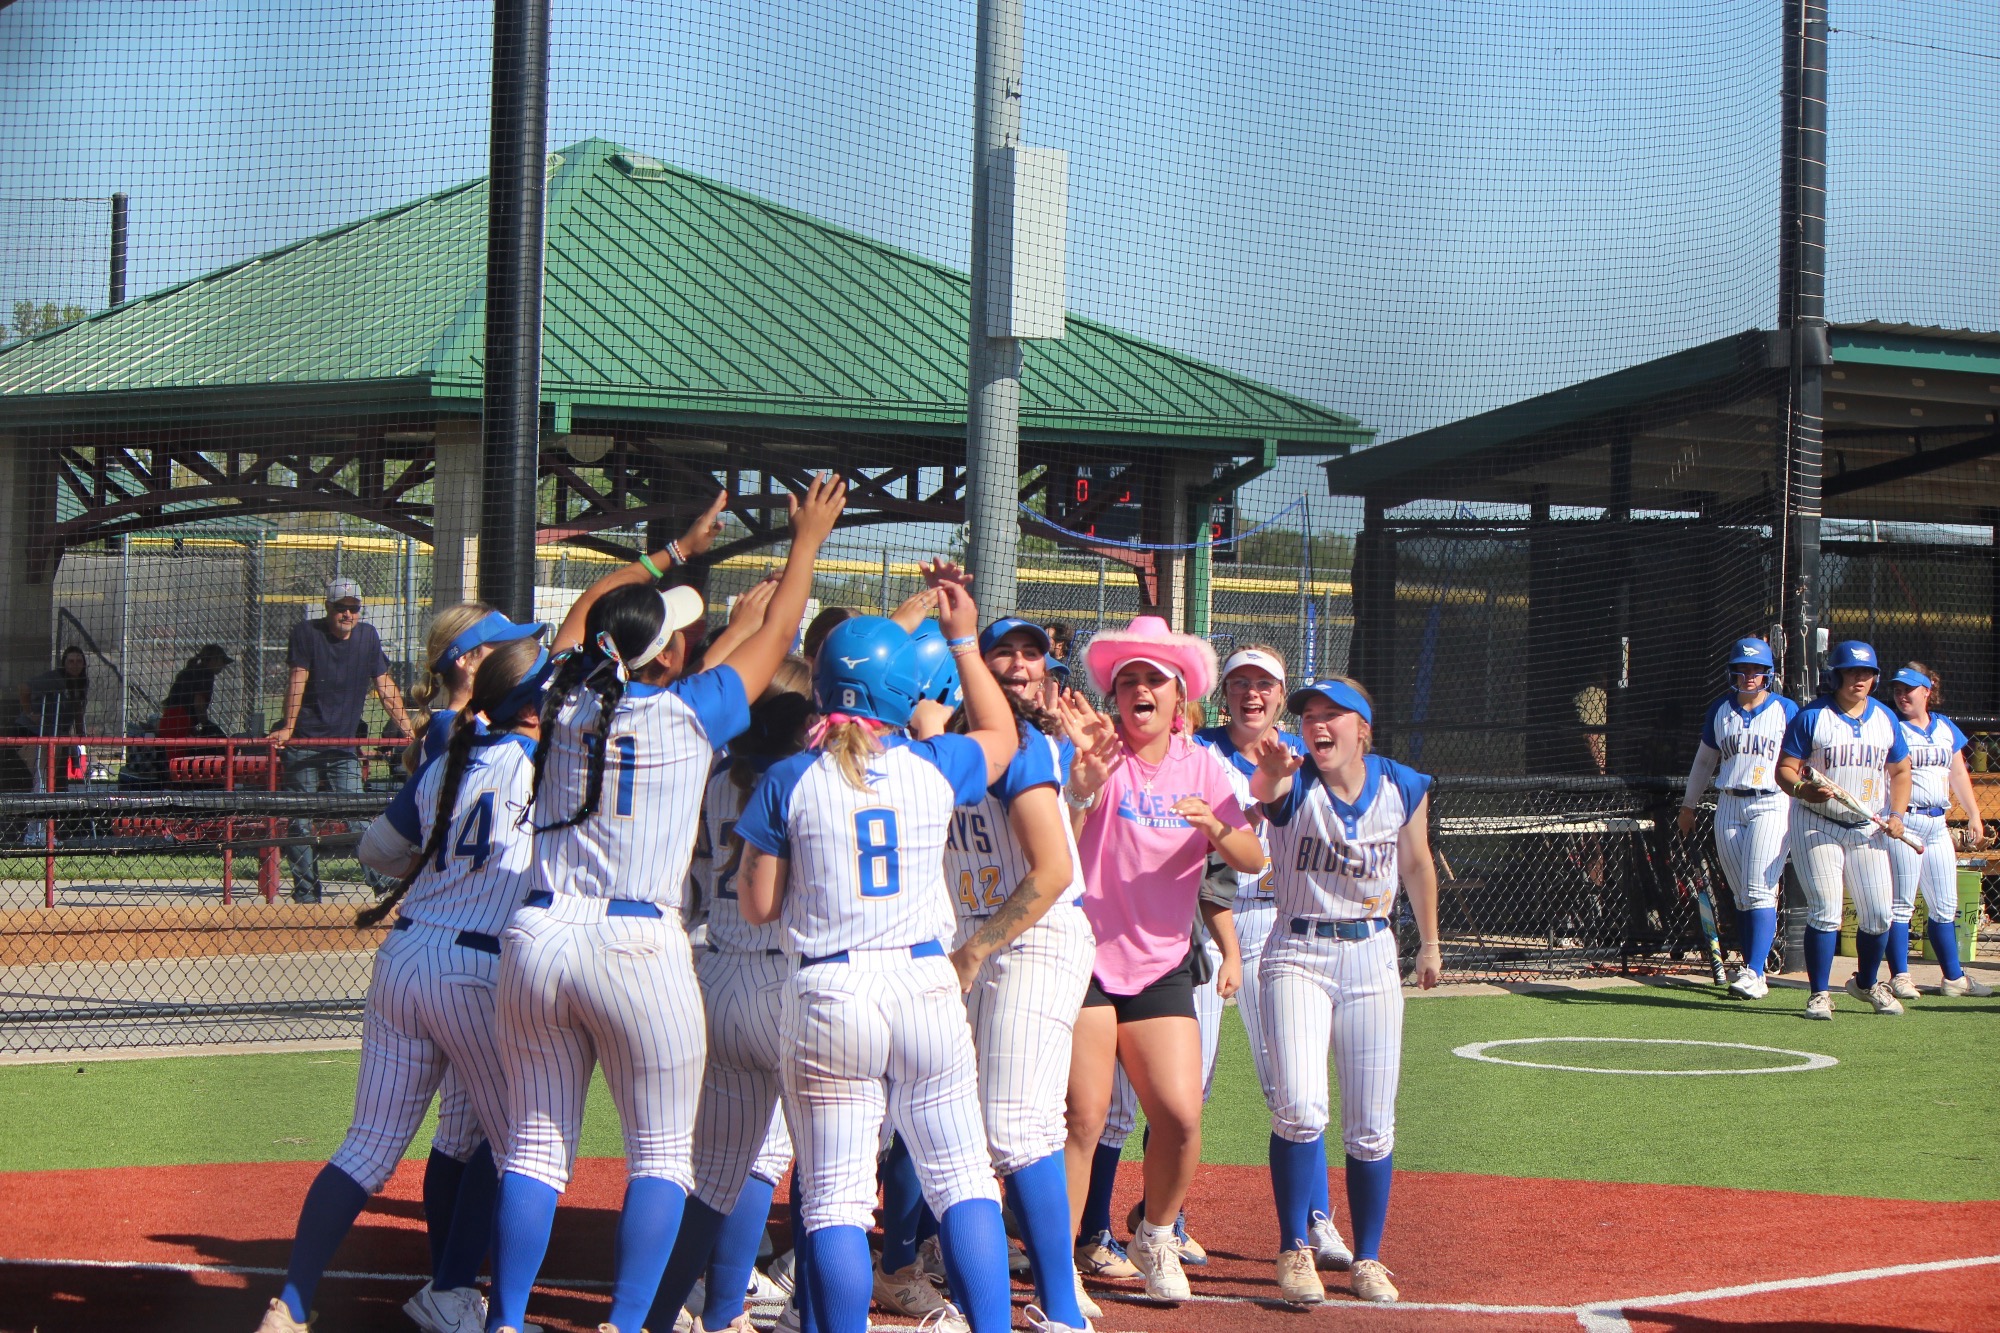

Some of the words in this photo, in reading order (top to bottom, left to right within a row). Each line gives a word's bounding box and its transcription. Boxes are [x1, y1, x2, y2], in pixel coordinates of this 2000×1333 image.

[842, 688, 856, 708] 8
[1136, 816, 1181, 828] SOFTBALL
[850, 805, 903, 900] 8
[959, 865, 1005, 912] 42
